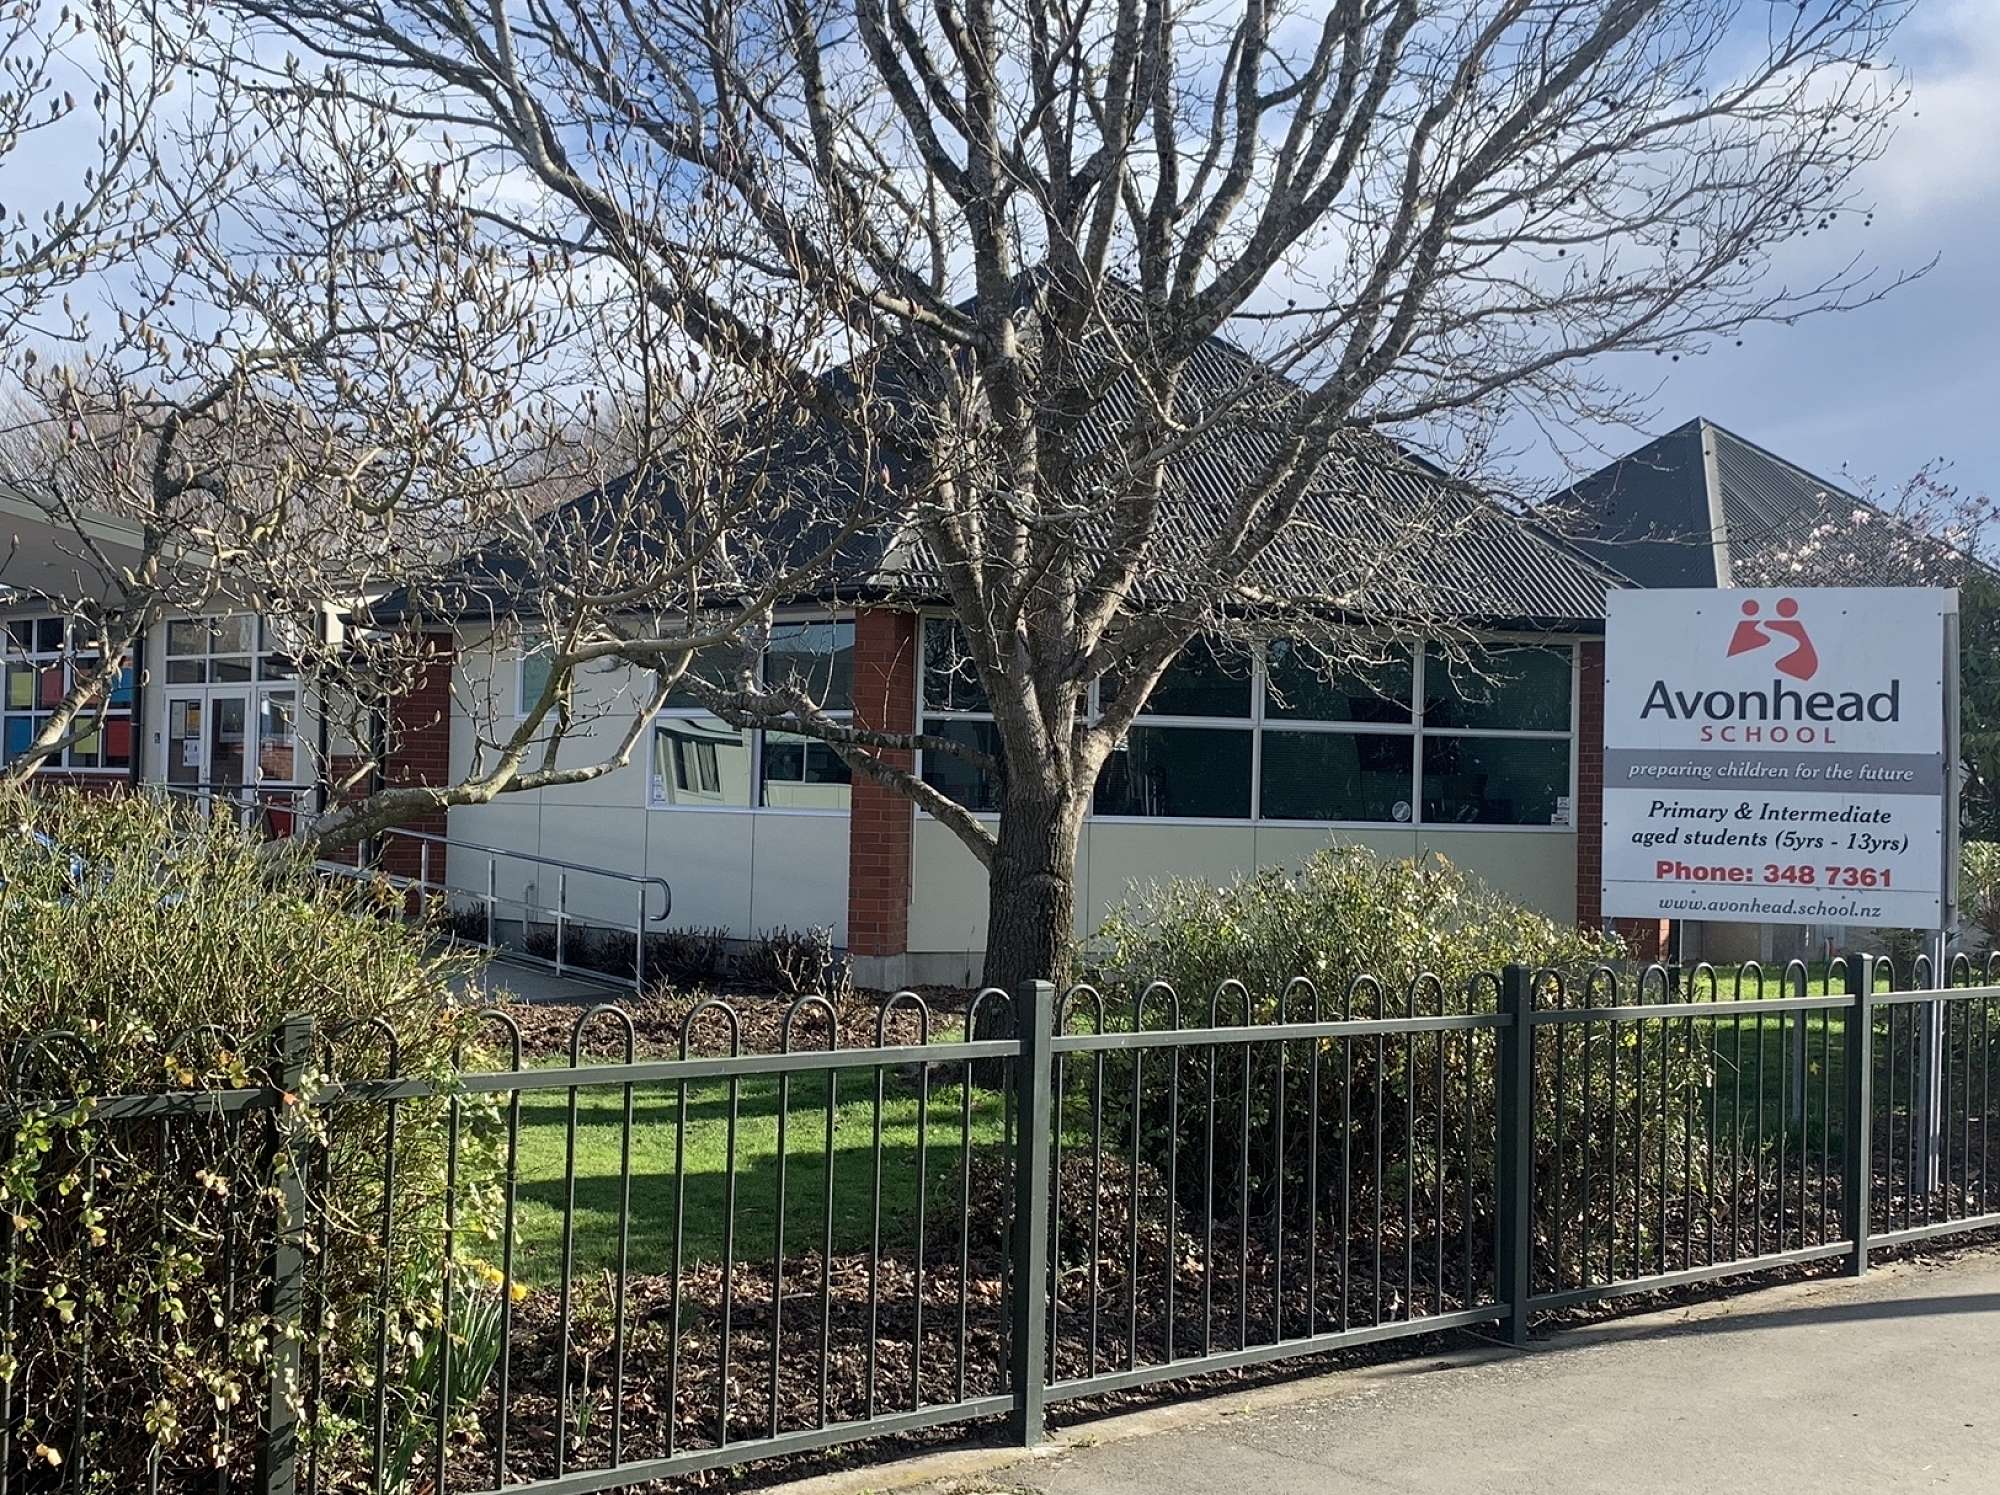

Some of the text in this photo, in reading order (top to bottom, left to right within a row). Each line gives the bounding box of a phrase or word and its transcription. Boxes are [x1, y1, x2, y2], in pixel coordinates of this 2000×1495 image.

[1640, 679, 1899, 722] Avonhead
[1700, 726, 1836, 744] SCHOOL
[1627, 762, 1914, 782] preparing children for the future
[1648, 801, 1892, 824] Primary & Intermediate
[1631, 829, 1679, 849] aged
[1684, 831, 1768, 847] students
[1775, 831, 1824, 850] (5yrs
[1847, 832, 1909, 854] 13yrs)
[1656, 860, 1892, 887] Phone: 348 7361
[1658, 895, 1881, 918] www.avonhead.school.nz
